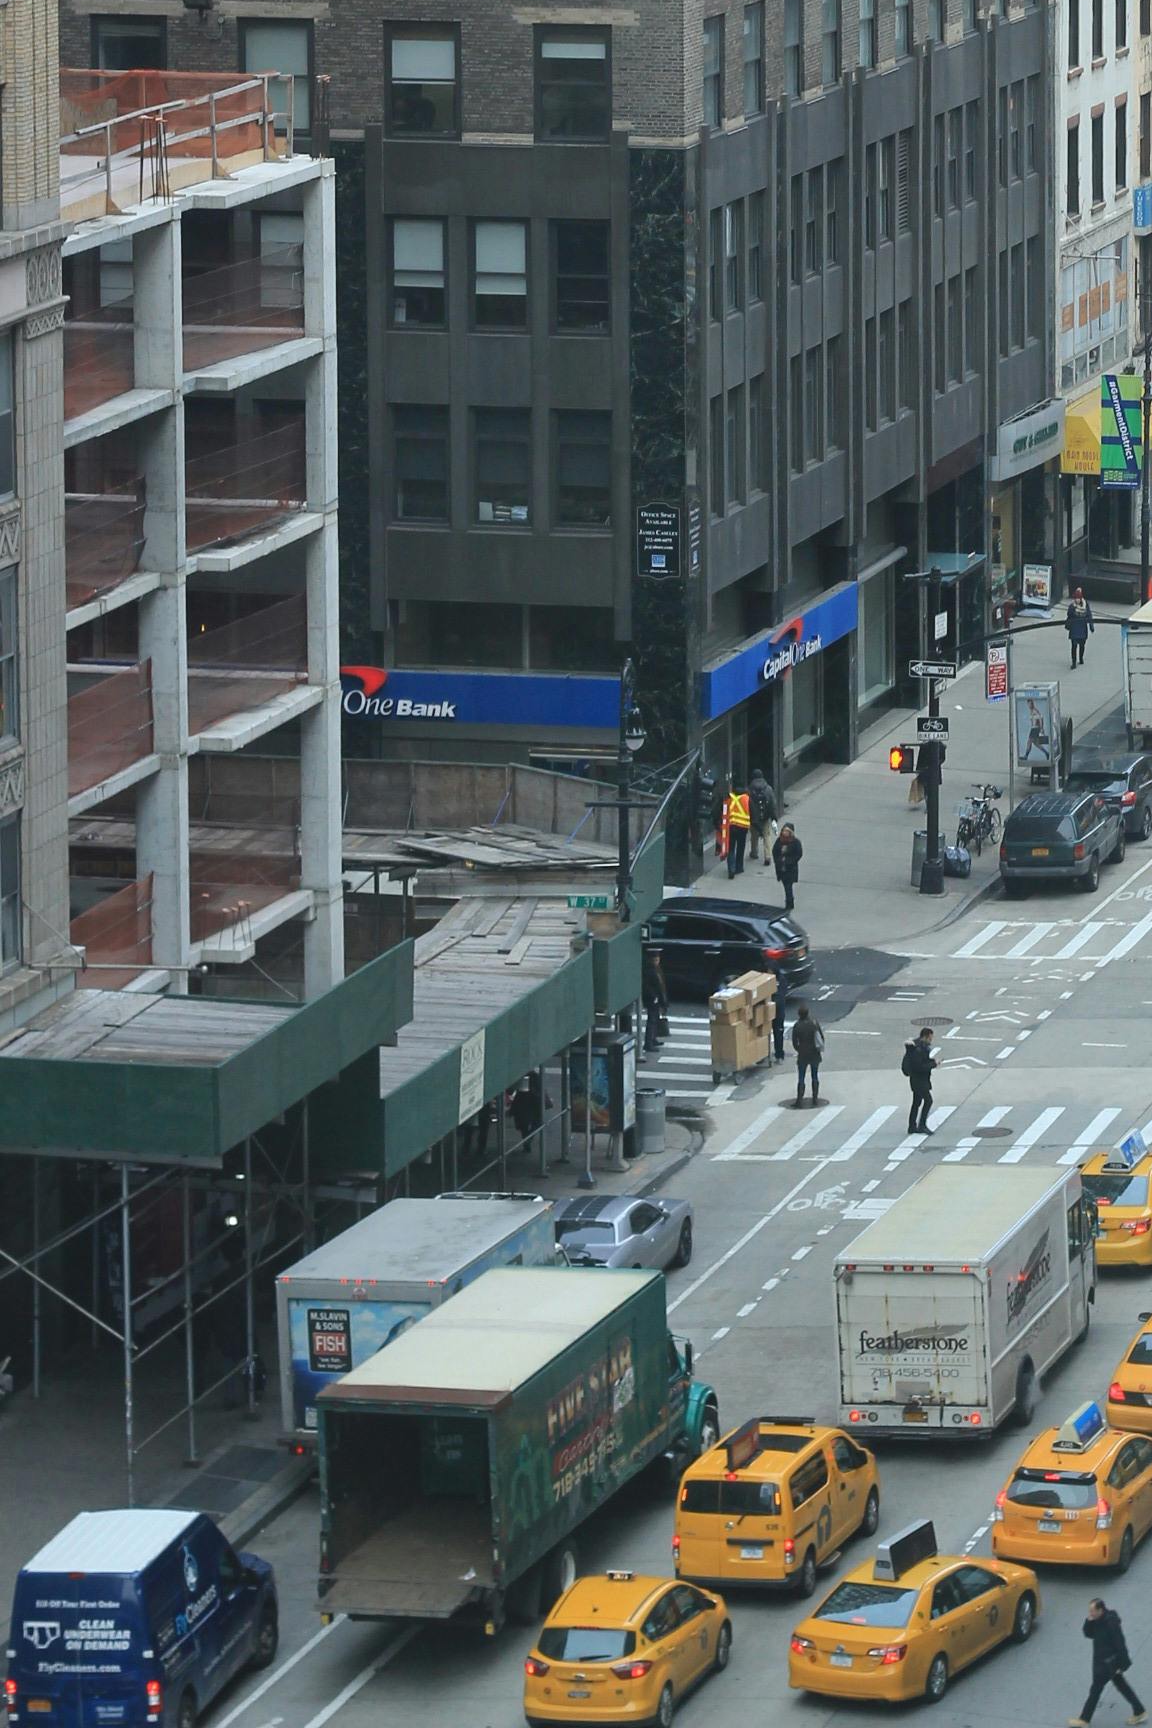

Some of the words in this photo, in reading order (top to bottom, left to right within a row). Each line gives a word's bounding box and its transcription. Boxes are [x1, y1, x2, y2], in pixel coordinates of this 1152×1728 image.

[1108, 381, 1134, 461] #GarmentDistrict
[805, 634, 822, 658] Bank
[937, 666, 953, 674] WAY
[396, 699, 456, 718] Bank
[568, 896, 578, 908] W
[583, 897, 596, 908] 37
[310, 1312, 348, 1321] M.SLAVIN
[315, 1322, 321, 1330] &
[322, 1322, 344, 1331] SONS
[315, 1335, 346, 1352] FISH
[857, 1330, 969, 1355] featherstone
[869, 1368, 960, 1378] 718-456-5400
[78, 1619, 115, 1629] CLEAN
[63, 1630, 131, 1640] UNDERWEAR
[65, 1640, 82, 1650] ON
[83, 1640, 130, 1650] DEMAND
